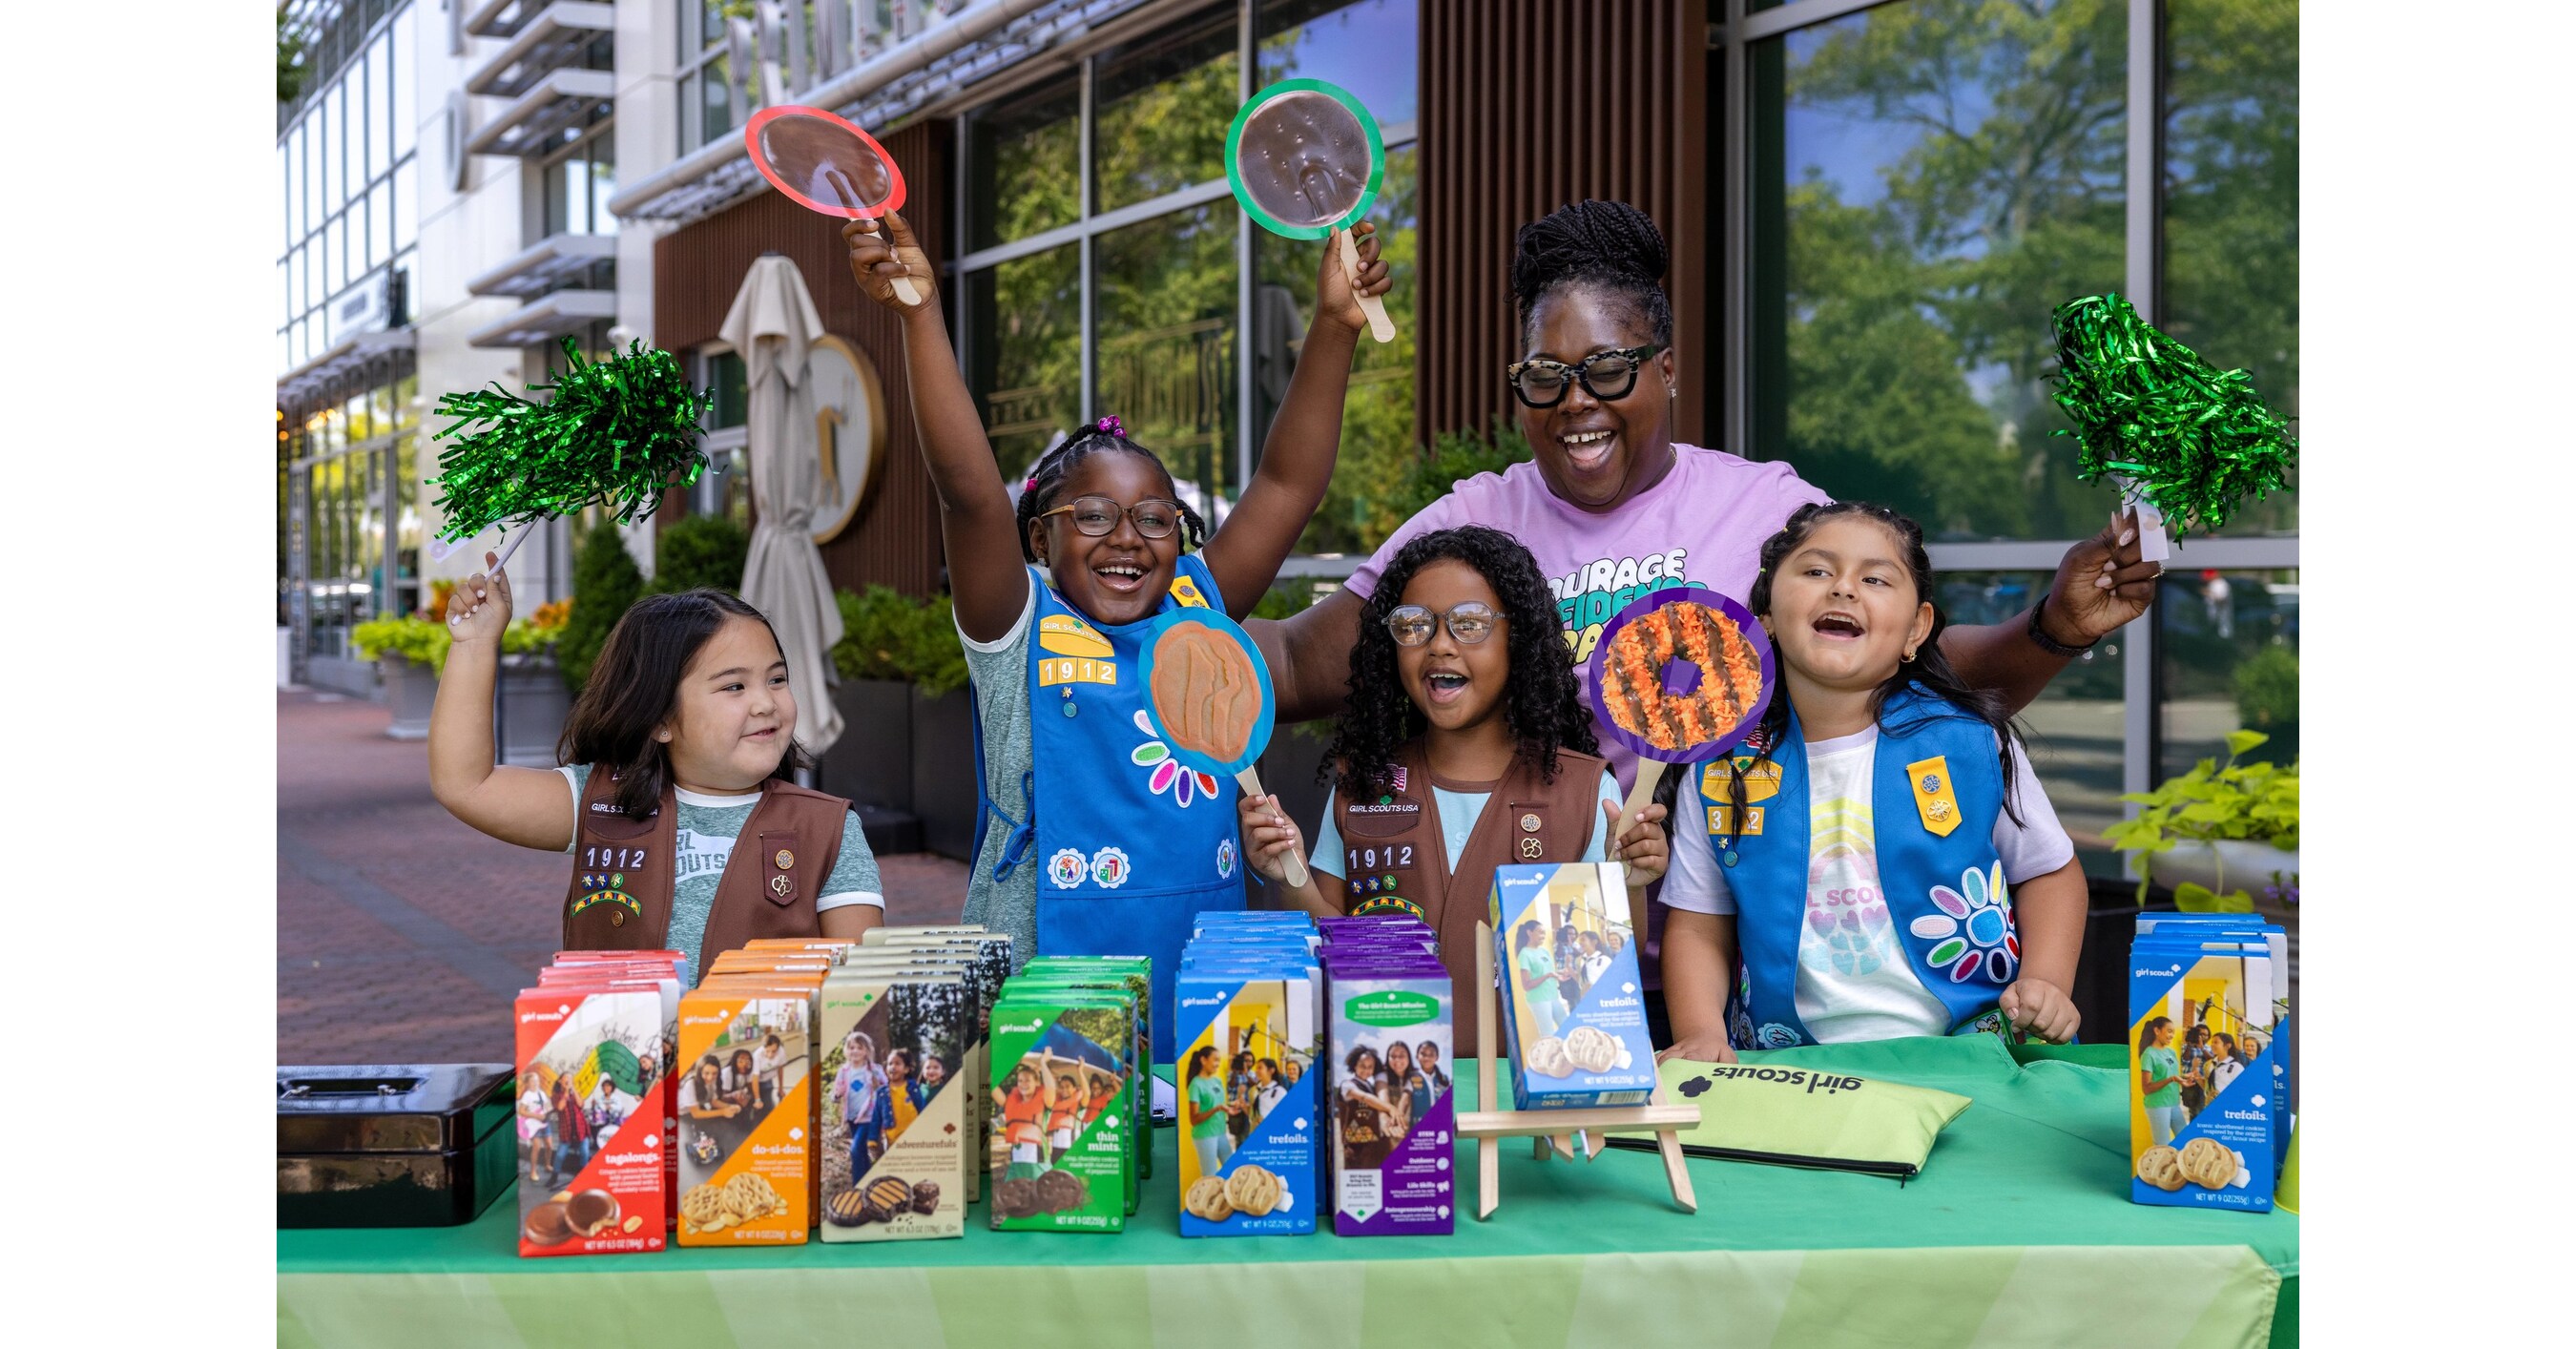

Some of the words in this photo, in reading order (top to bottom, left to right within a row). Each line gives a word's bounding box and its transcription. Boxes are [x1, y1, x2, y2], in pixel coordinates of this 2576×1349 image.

[1043, 622, 1060, 631] GIRL
[1045, 662, 1112, 681] 1912
[1708, 769, 1726, 778] GIRL
[592, 803, 610, 814] GIRL
[1368, 804, 1402, 813] SCOUTS
[1402, 803, 1419, 812] USA
[1712, 810, 1759, 830] 32
[587, 847, 645, 869] 1912
[1349, 846, 1412, 869] 1912
[675, 854, 726, 878] OUTS
[1504, 878, 1516, 887] girl
[2135, 967, 2149, 978] girl
[1182, 997, 1196, 1007] girl
[521, 1011, 536, 1024] girl
[536, 1012, 564, 1022] scouts
[999, 1024, 1012, 1034] girl
[1712, 1067, 1806, 1085] scouts
[1807, 1073, 1865, 1094] girl
[1096, 1131, 1119, 1142] thin
[2195, 1193, 2207, 1201] NET
[2207, 1193, 2216, 1202] WT
[1055, 1215, 1067, 1225] NET
[584, 1240, 596, 1251] NET
